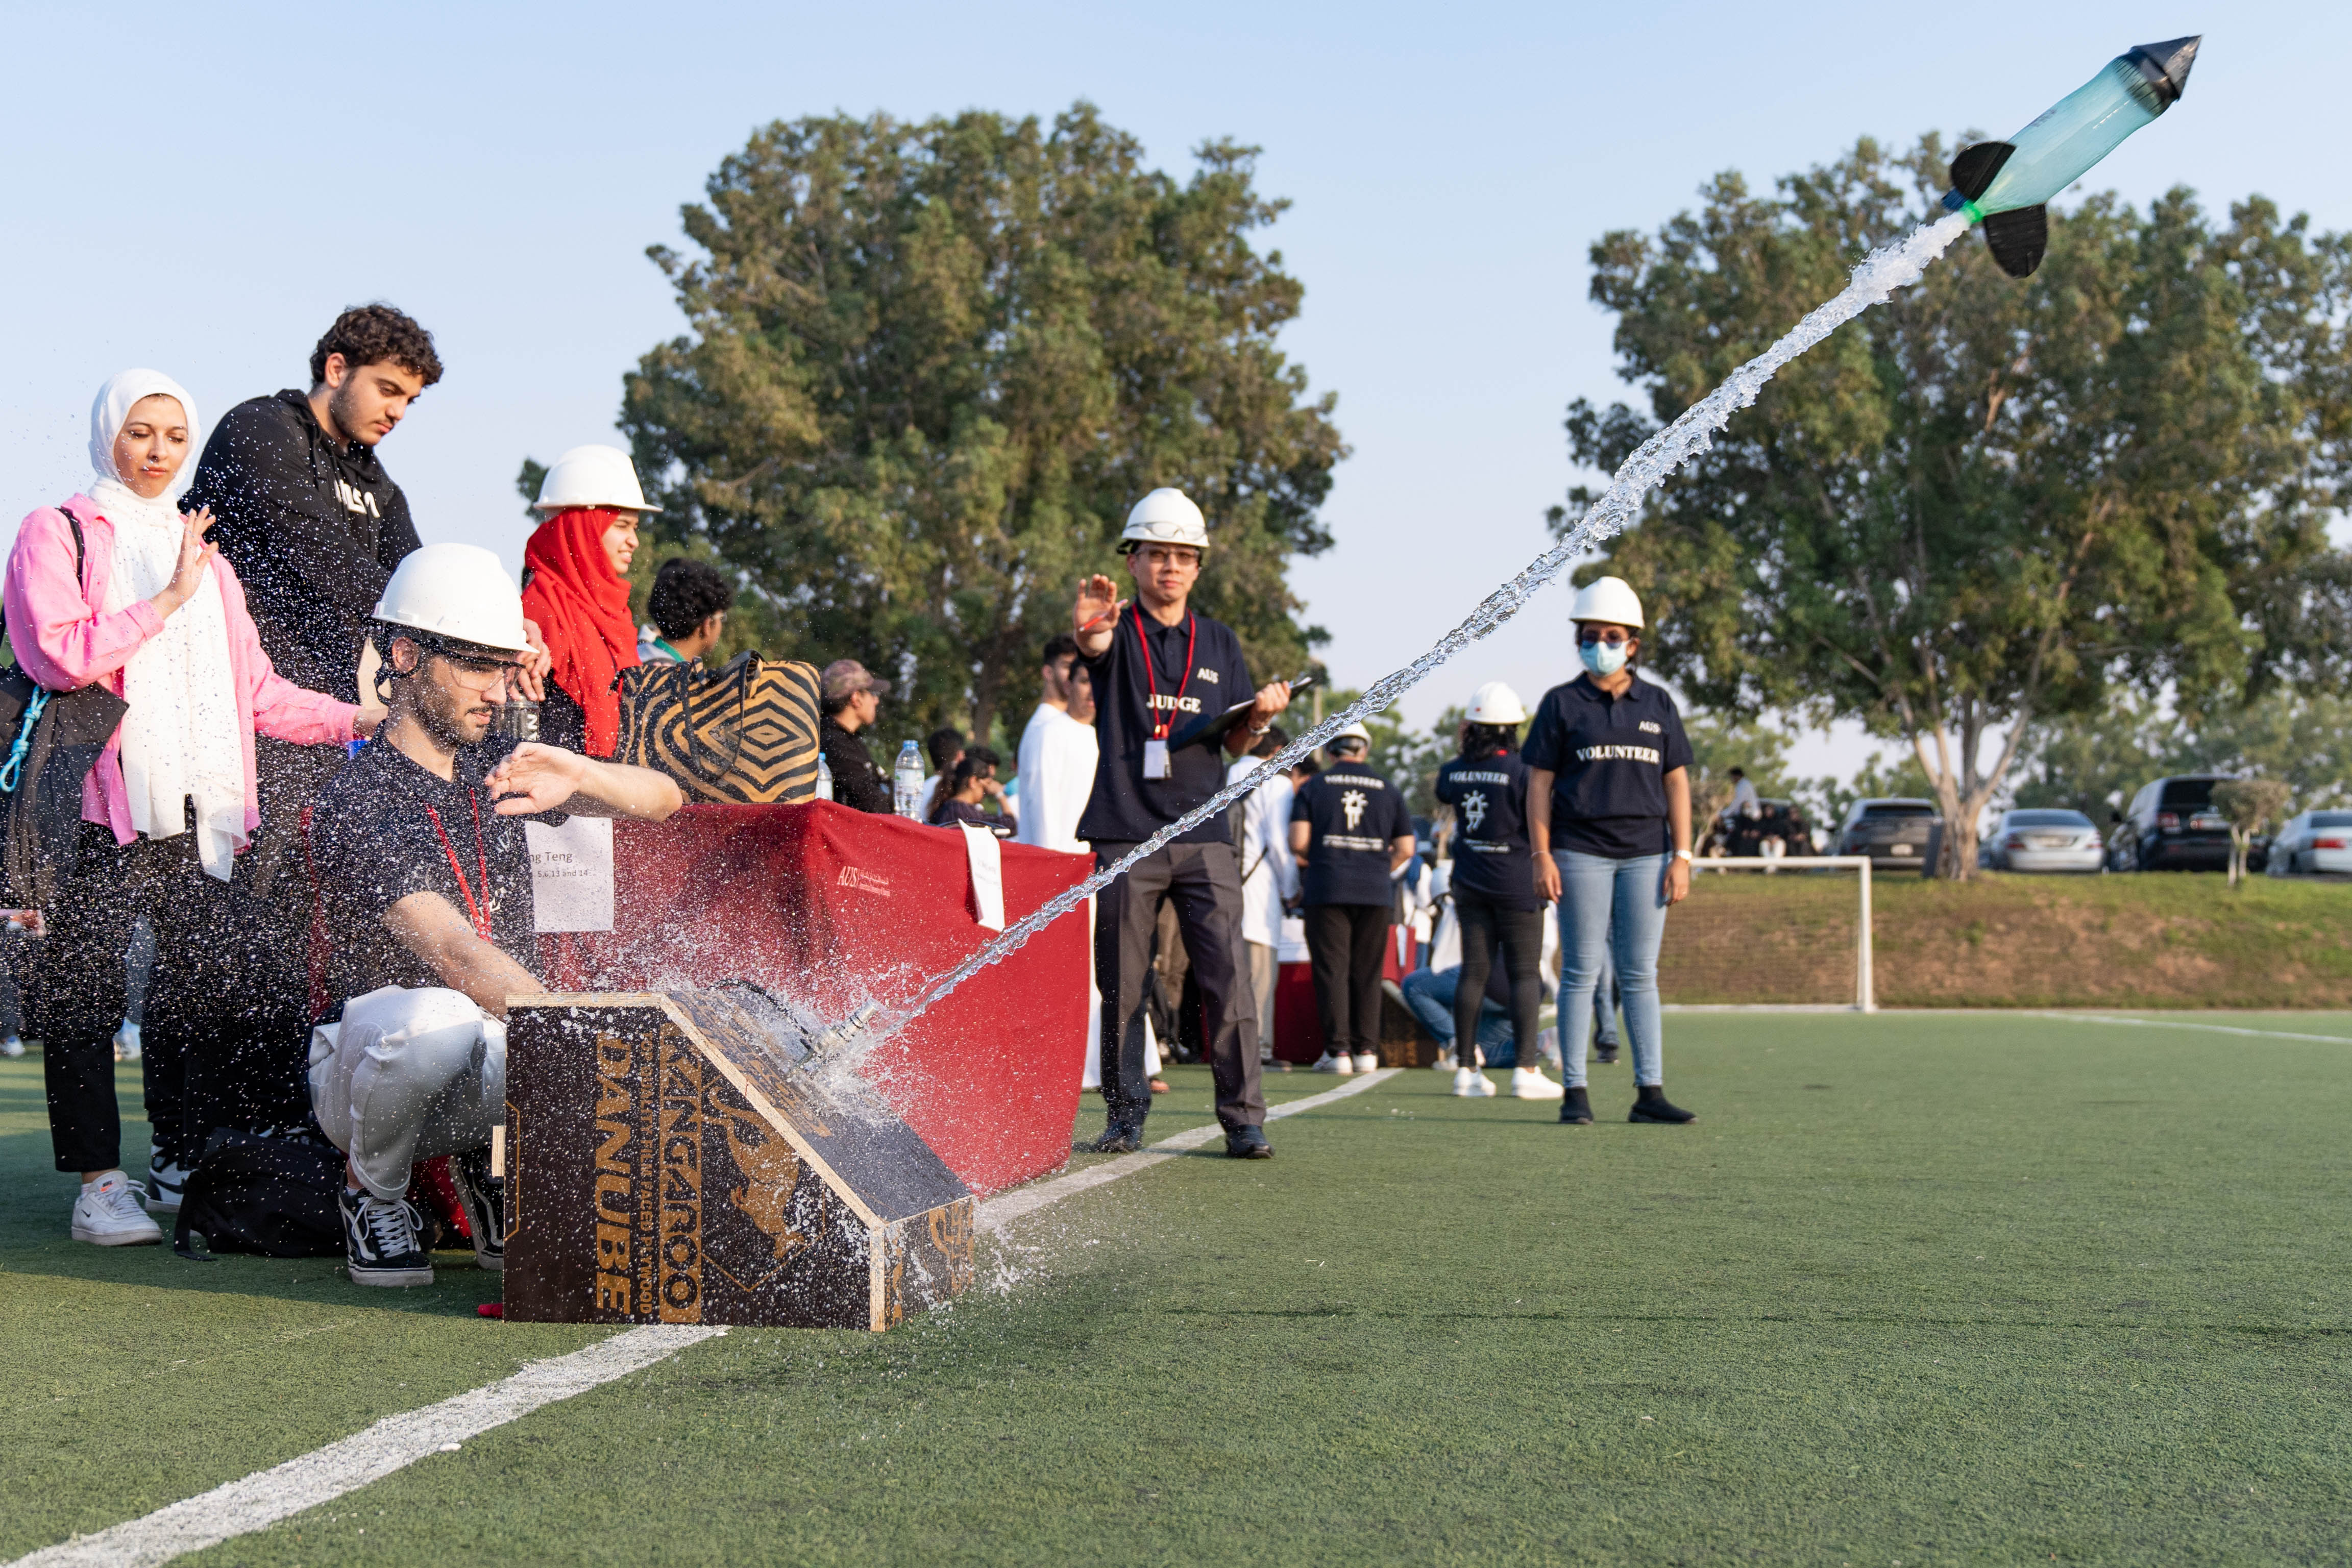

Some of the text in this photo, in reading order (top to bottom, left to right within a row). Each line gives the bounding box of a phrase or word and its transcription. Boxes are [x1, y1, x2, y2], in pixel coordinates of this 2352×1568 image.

[1197, 667, 1219, 684] AUS
[1146, 693, 1202, 714] JUDGE
[1638, 721, 1661, 735] AUS
[1576, 740, 1660, 765] VOLUNTEER
[545, 851, 573, 863] Teng
[837, 866, 858, 887] AUS
[595, 1032, 631, 1314] DANUBE
[640, 1032, 653, 1314] TOP QUALITY FILM FACED PLYWOOD
[663, 1035, 698, 1310] KANGAROO
